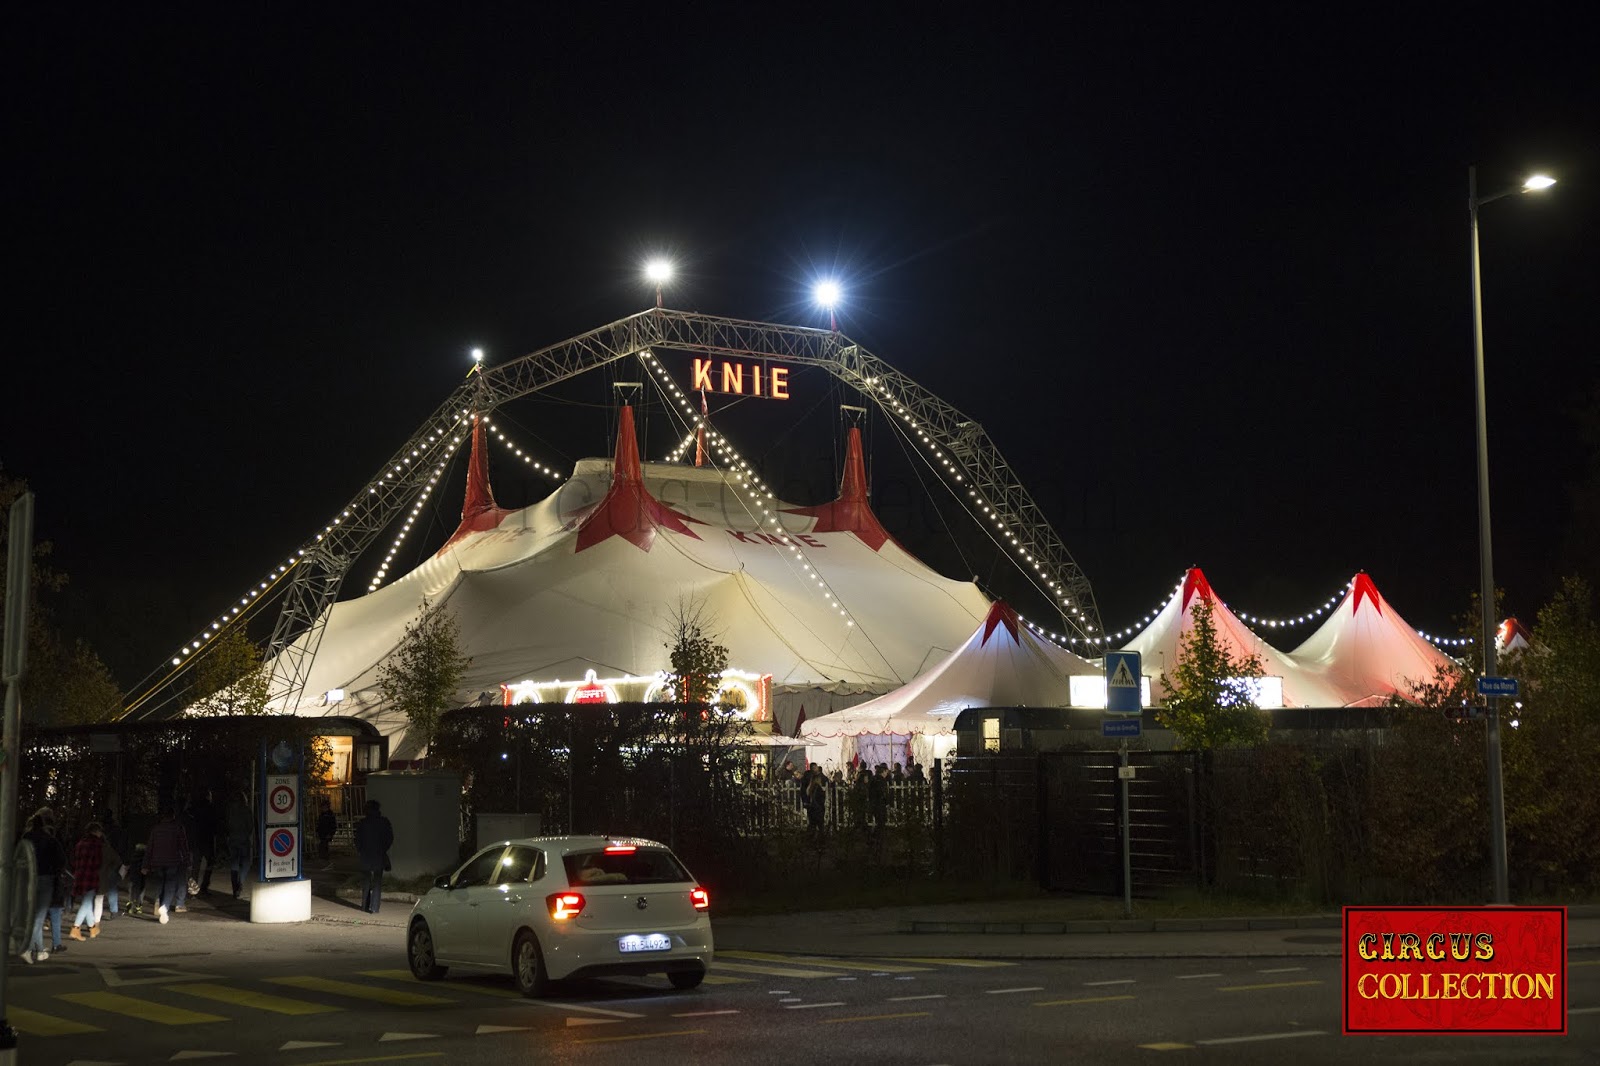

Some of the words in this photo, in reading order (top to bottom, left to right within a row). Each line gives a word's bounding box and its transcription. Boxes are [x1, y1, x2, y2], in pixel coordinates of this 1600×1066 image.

[693, 358, 790, 400] KNIE
[725, 529, 827, 548] KNIE
[277, 794, 288, 805] 30
